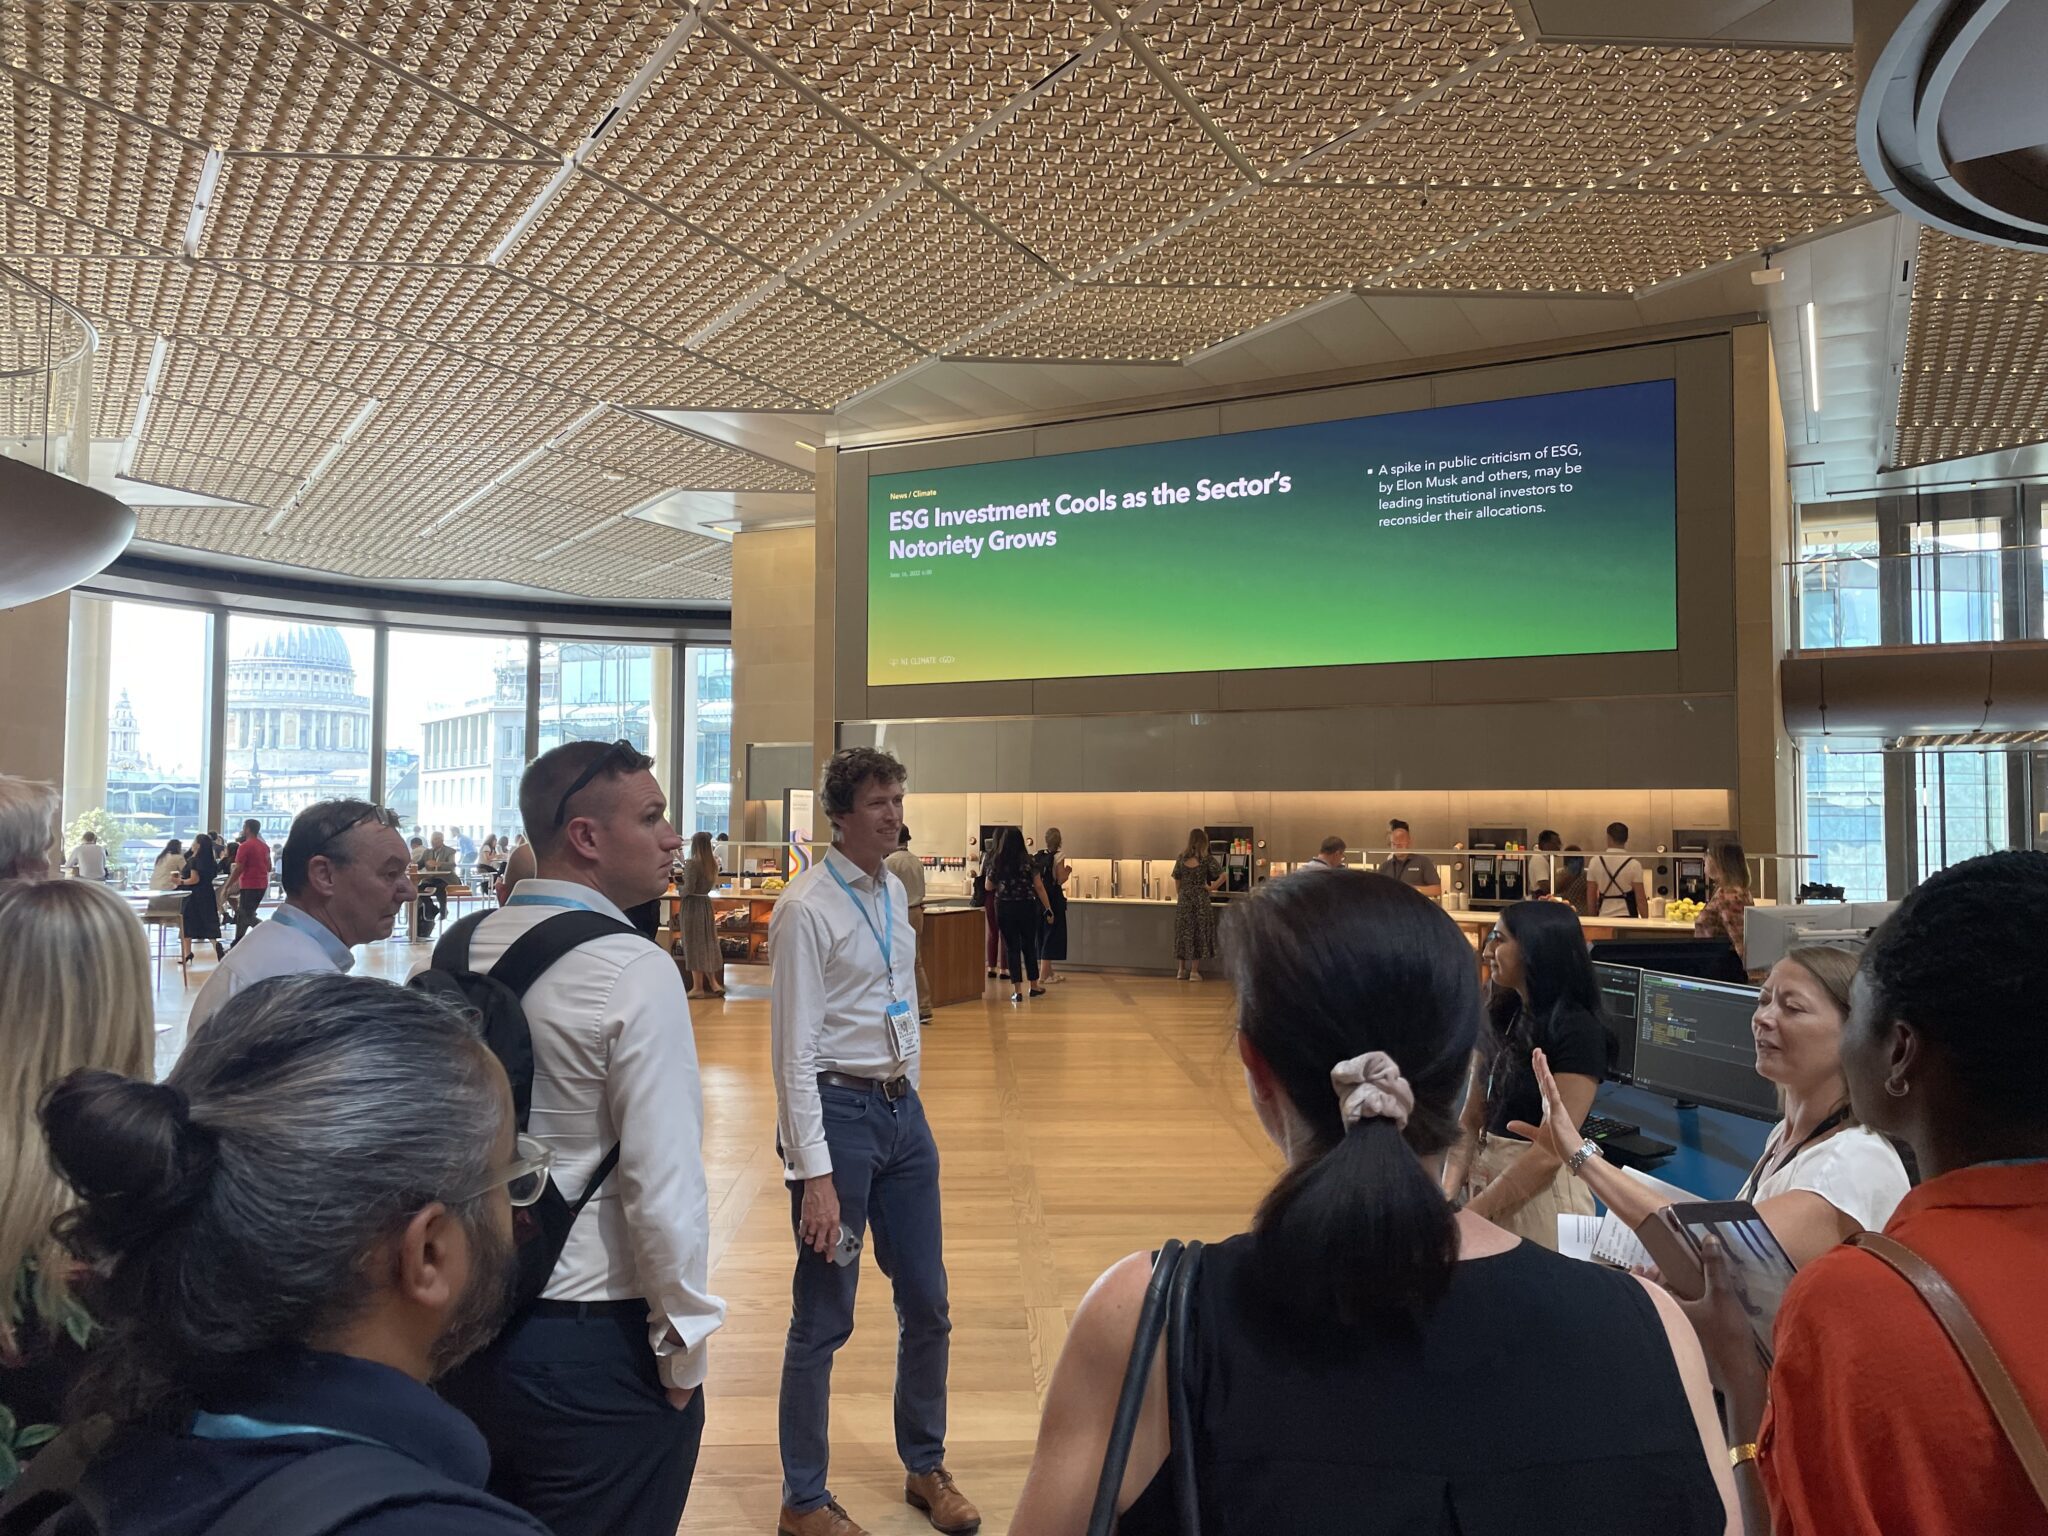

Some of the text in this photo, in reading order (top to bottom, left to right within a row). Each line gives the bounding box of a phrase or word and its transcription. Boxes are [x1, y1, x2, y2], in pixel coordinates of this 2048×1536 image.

[1378, 444, 1582, 477] A spike in public criticism of ESG,
[1378, 462, 1582, 495] by Elon Musk and others, may be
[889, 471, 1292, 531] ESG Investment Cools as the Sector's
[913, 490, 937, 498] Climate
[1379, 483, 1573, 510] leading institutional investors to
[1379, 504, 1546, 527] reconsider their allocations.
[889, 528, 1057, 560] Notoriety Grows
[910, 656, 937, 664] CLIMATE
